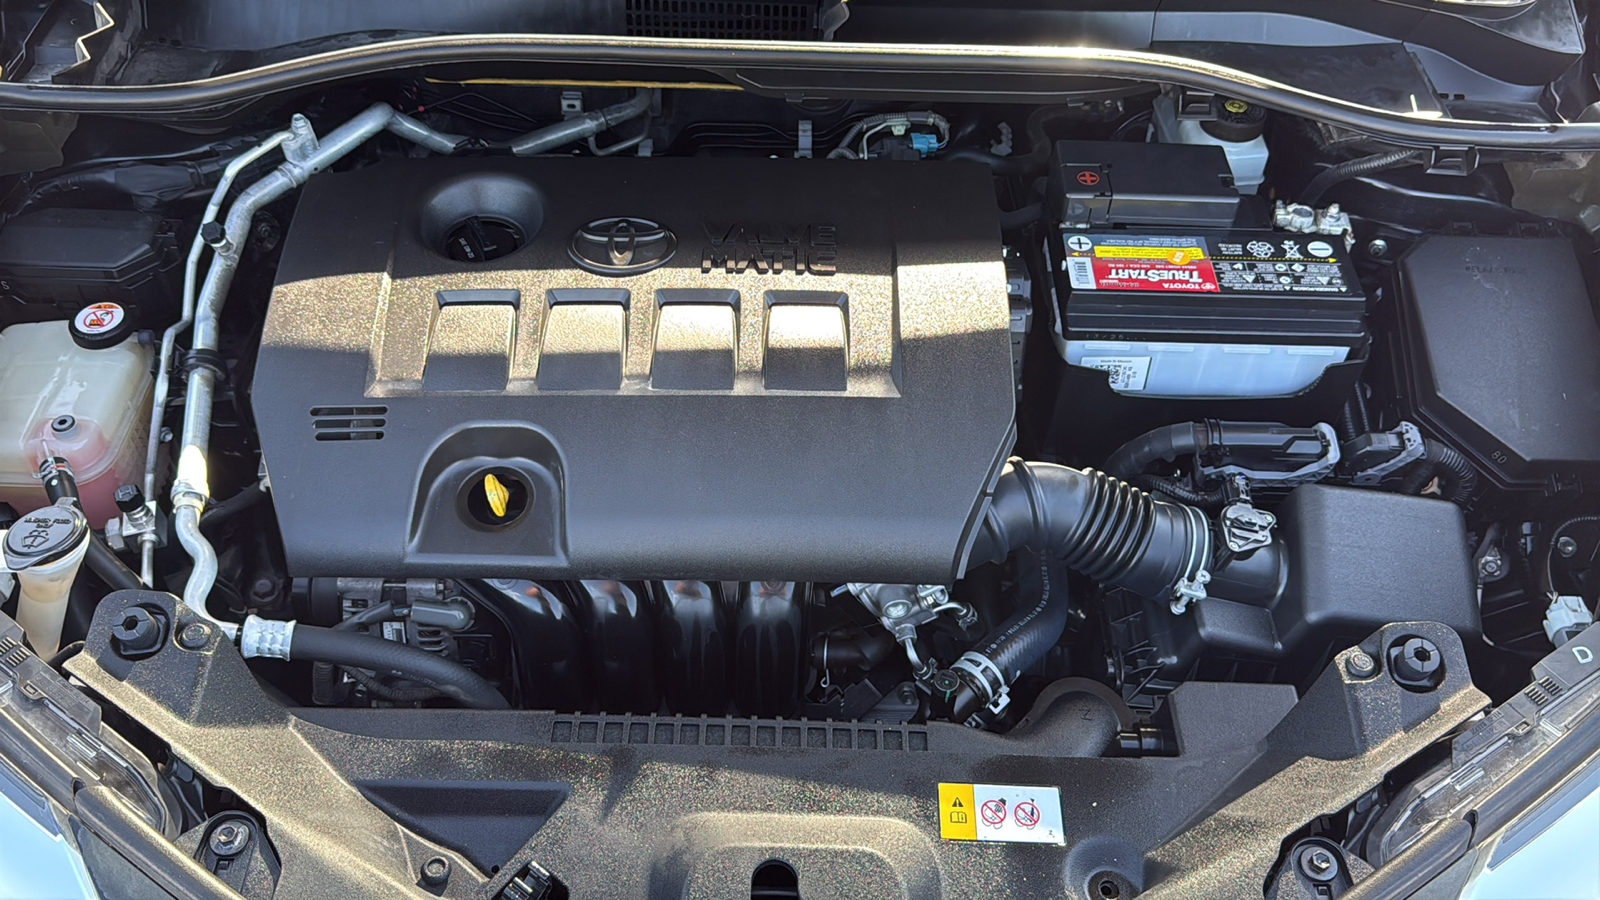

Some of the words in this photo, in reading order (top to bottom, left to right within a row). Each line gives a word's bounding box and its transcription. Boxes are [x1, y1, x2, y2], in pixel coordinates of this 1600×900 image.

[701, 221, 836, 247] VALVE
[701, 248, 836, 276] MATIC
[1162, 282, 1200, 290] TOYOTA
[1572, 646, 1593, 664] D
